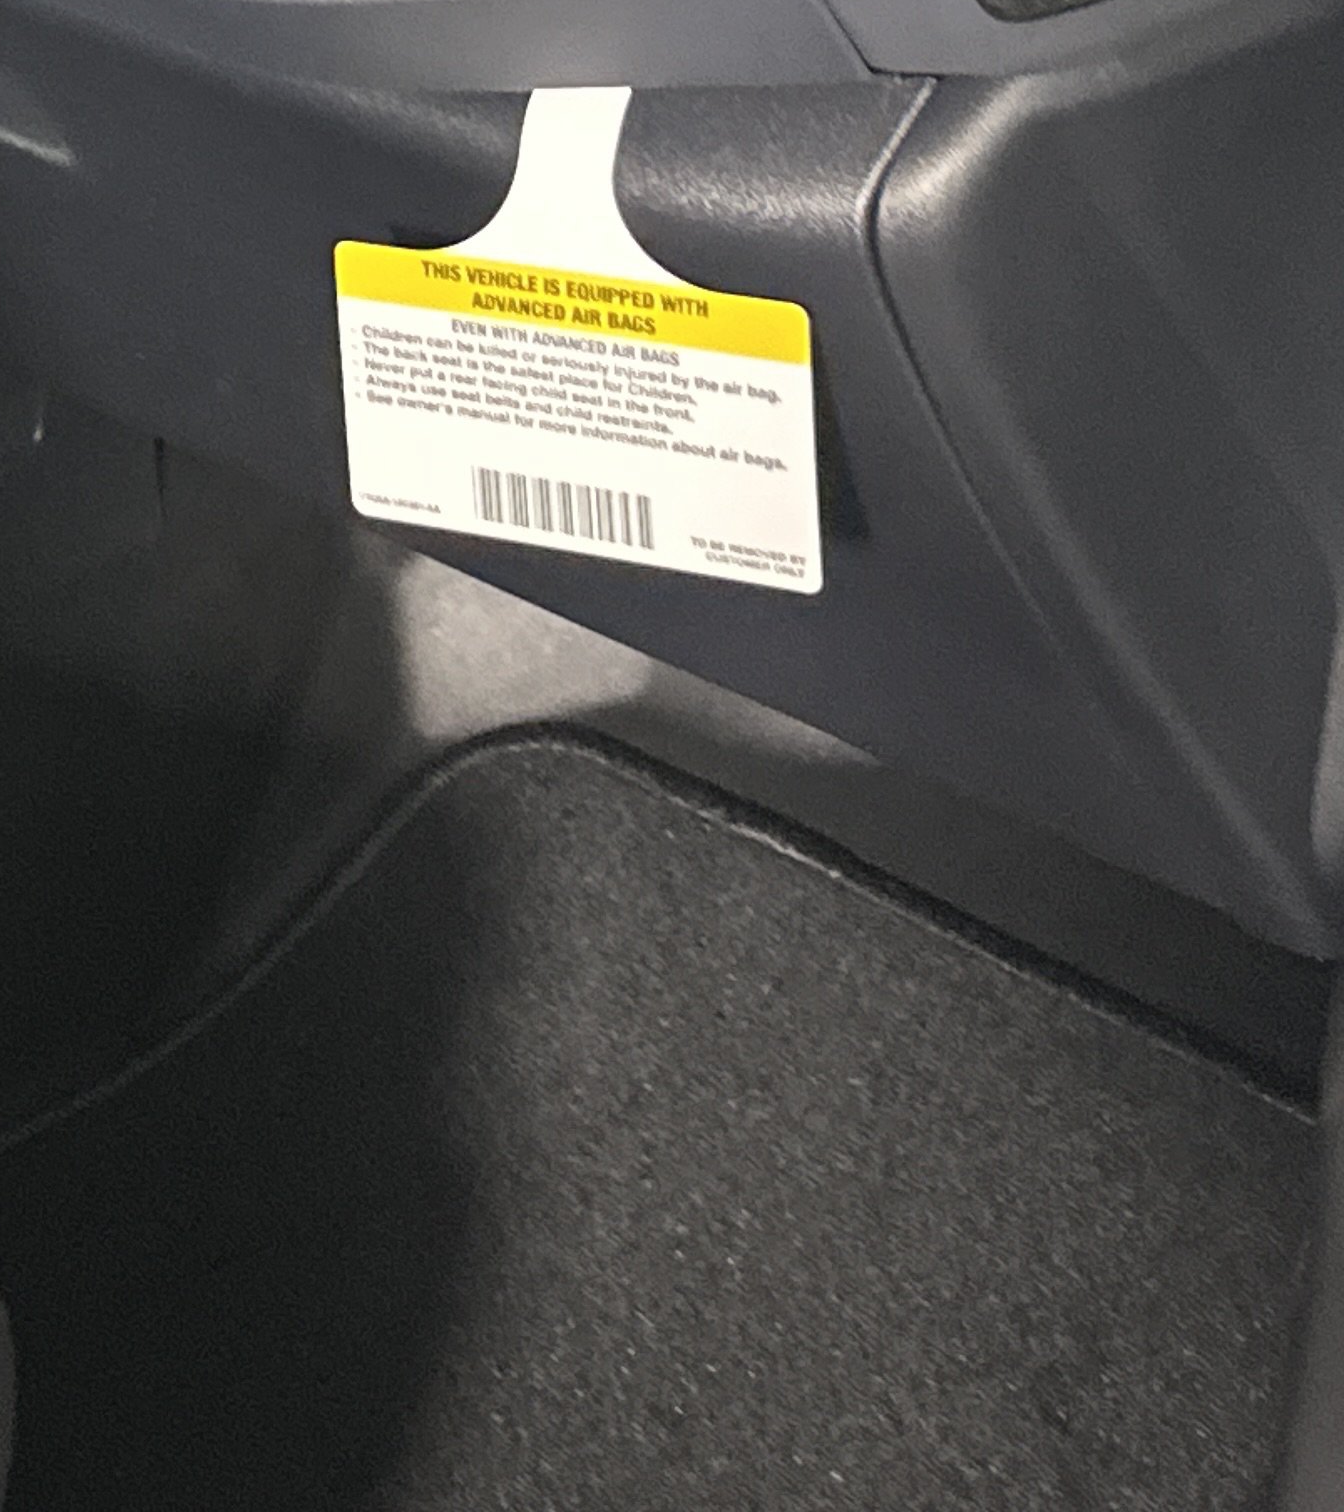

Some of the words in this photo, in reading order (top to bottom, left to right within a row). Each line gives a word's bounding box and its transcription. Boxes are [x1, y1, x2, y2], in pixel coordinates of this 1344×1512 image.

[421, 259, 461, 281] THIS
[466, 265, 537, 292] VEHICLE
[544, 277, 559, 296] IS
[566, 280, 653, 309] EQUIPPED
[660, 293, 708, 318] WITH
[472, 291, 565, 321] ADVANCED
[571, 306, 601, 326] AIR
[607, 311, 655, 335] BAGS
[362, 324, 422, 345] Children
[427, 337, 451, 349] can
[457, 339, 473, 353] be
[478, 343, 516, 359] killed
[522, 352, 535, 363] or
[542, 352, 608, 377] seriously
[614, 364, 666, 386] injured
[671, 372, 688, 390] by
[694, 376, 718, 391] the
[723, 380, 741, 396] air
[747, 383, 781, 405] bag.
[451, 318, 486, 336] EVEN
[492, 324, 527, 342] WITH
[532, 330, 606, 355] ADVANCED
[612, 342, 635, 359] AIR
[640, 346, 680, 366] BAGS
[363, 341, 389, 355] The
[393, 346, 427, 362] back
[432, 353, 461, 367] seat
[466, 357, 478, 370] is
[483, 360, 505, 374] the
[510, 364, 553, 381] safest
[559, 372, 597, 390] place
[603, 380, 622, 393] for
[628, 383, 697, 406] Children.
[365, 357, 404, 374] Never
[410, 365, 432, 381] put
[437, 370, 446, 381] a
[450, 372, 477, 385] rear
[482, 376, 526, 396] facing
[531, 383, 566, 400] child
[572, 390, 602, 406] seat
[607, 395, 620, 408] in
[625, 398, 648, 413] the
[366, 374, 416, 393] Always
[421, 384, 446, 397] use
[452, 388, 480, 403] seat
[485, 393, 519, 409] belts
[525, 399, 551, 414] and
[556, 404, 592, 421] child
[366, 389, 392, 405] See
[457, 404, 509, 423] manual
[514, 412, 532, 427] for
[538, 418, 576, 434] more
[581, 424, 667, 450] information
[672, 439, 715, 458] about
[719, 445, 738, 462] air
